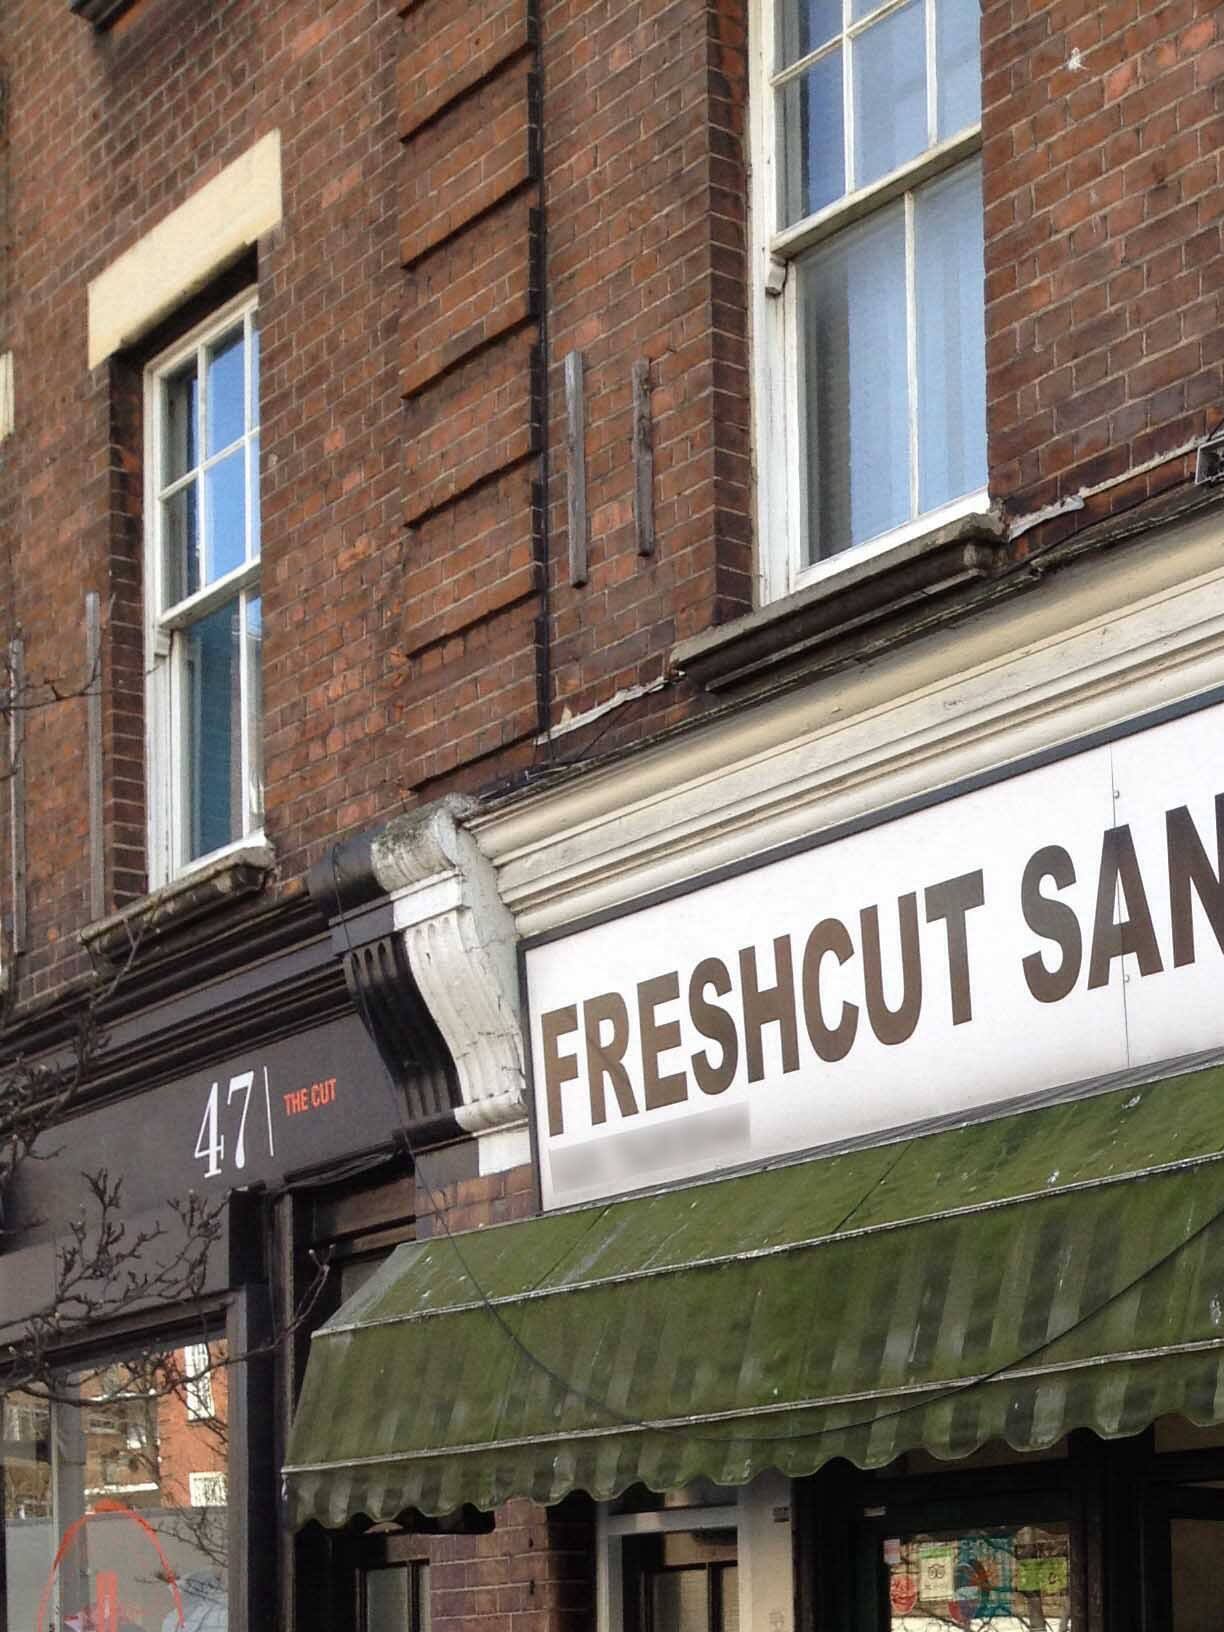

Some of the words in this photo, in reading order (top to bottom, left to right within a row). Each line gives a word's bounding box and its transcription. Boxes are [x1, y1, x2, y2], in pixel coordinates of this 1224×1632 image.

[541, 869, 985, 1138] FRESHCUT
[194, 1070, 254, 1178] 47
[283, 1088, 309, 1117] THE
[311, 1077, 338, 1108] CUT
